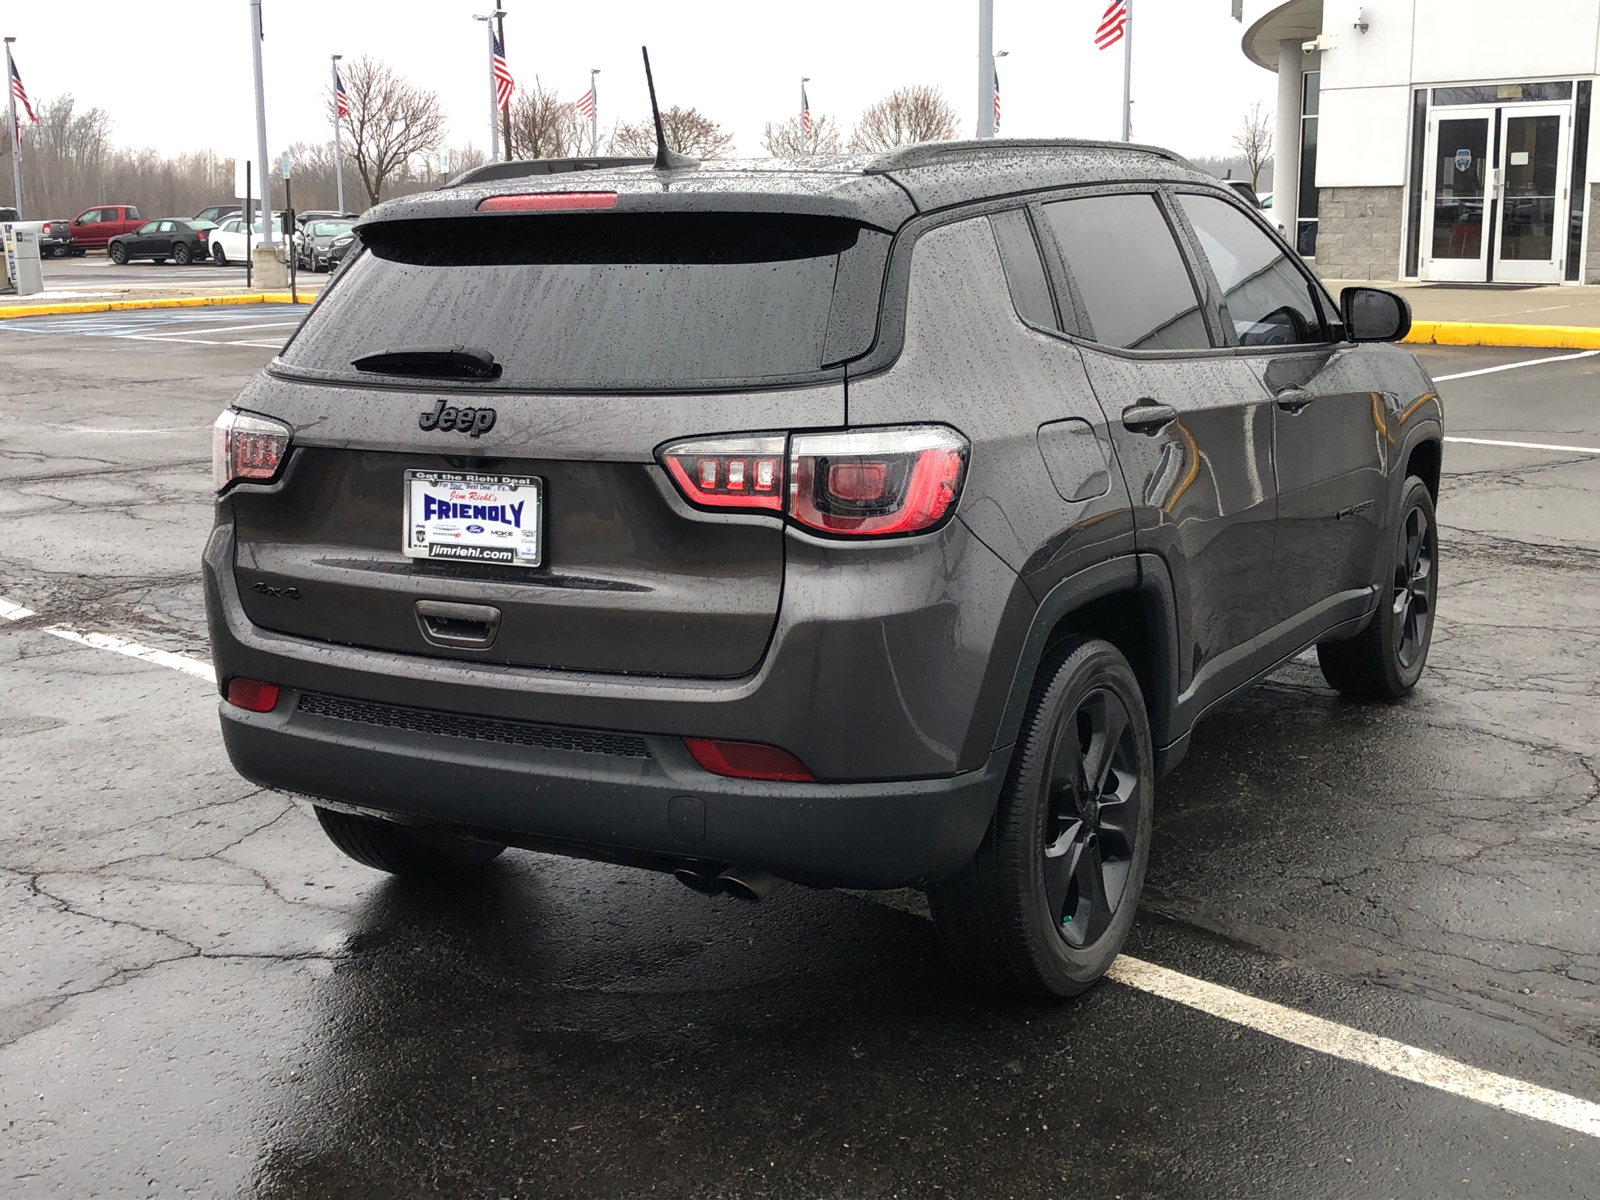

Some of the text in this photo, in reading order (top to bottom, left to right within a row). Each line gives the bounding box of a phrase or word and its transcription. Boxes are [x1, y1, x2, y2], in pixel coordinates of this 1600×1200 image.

[419, 400, 497, 438] Jeep
[416, 472, 438, 480] Get
[466, 475, 498, 483] Riehl
[502, 477, 530, 485] Deal
[449, 490, 498, 502] Jim Riehl's
[424, 492, 525, 529] FRIENDLY
[430, 544, 512, 561] jimriehl.com
[251, 581, 301, 601] 4x4
